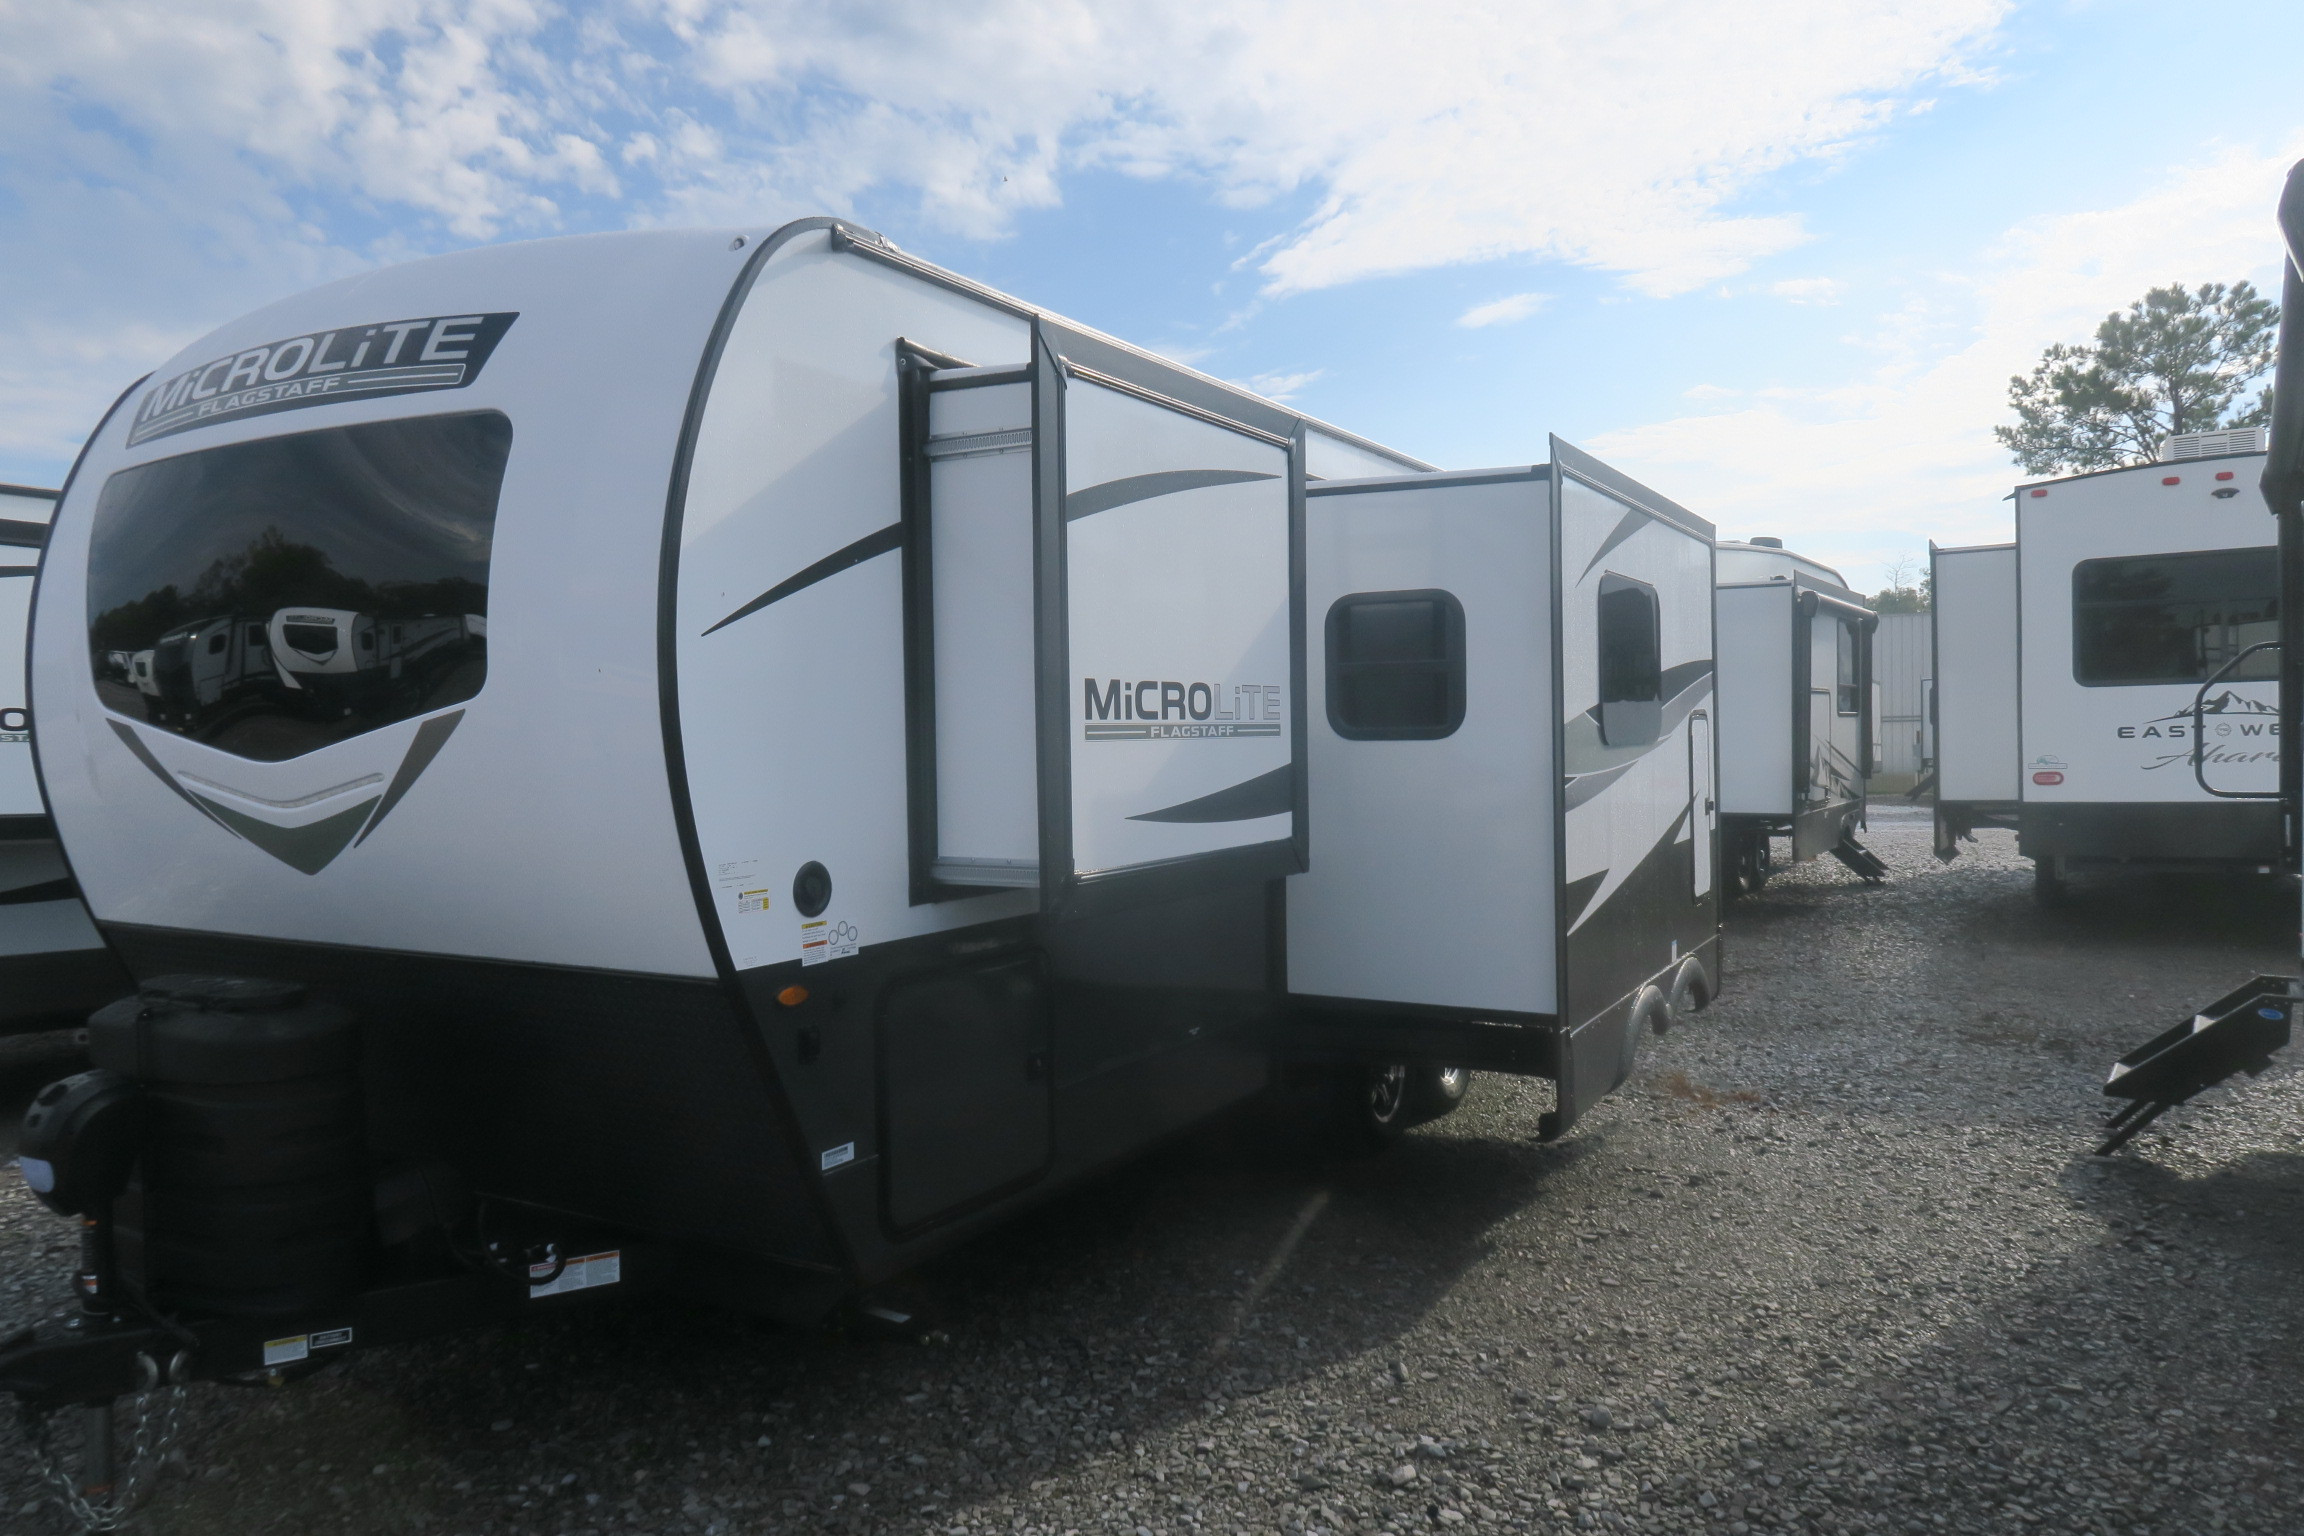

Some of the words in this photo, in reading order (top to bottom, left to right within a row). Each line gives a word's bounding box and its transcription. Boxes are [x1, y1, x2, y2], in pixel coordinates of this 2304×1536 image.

[198, 376, 341, 417] FLAGSTAFF
[1150, 725, 1234, 738] FLAGSTAFF
[2117, 725, 2206, 739] EAS
